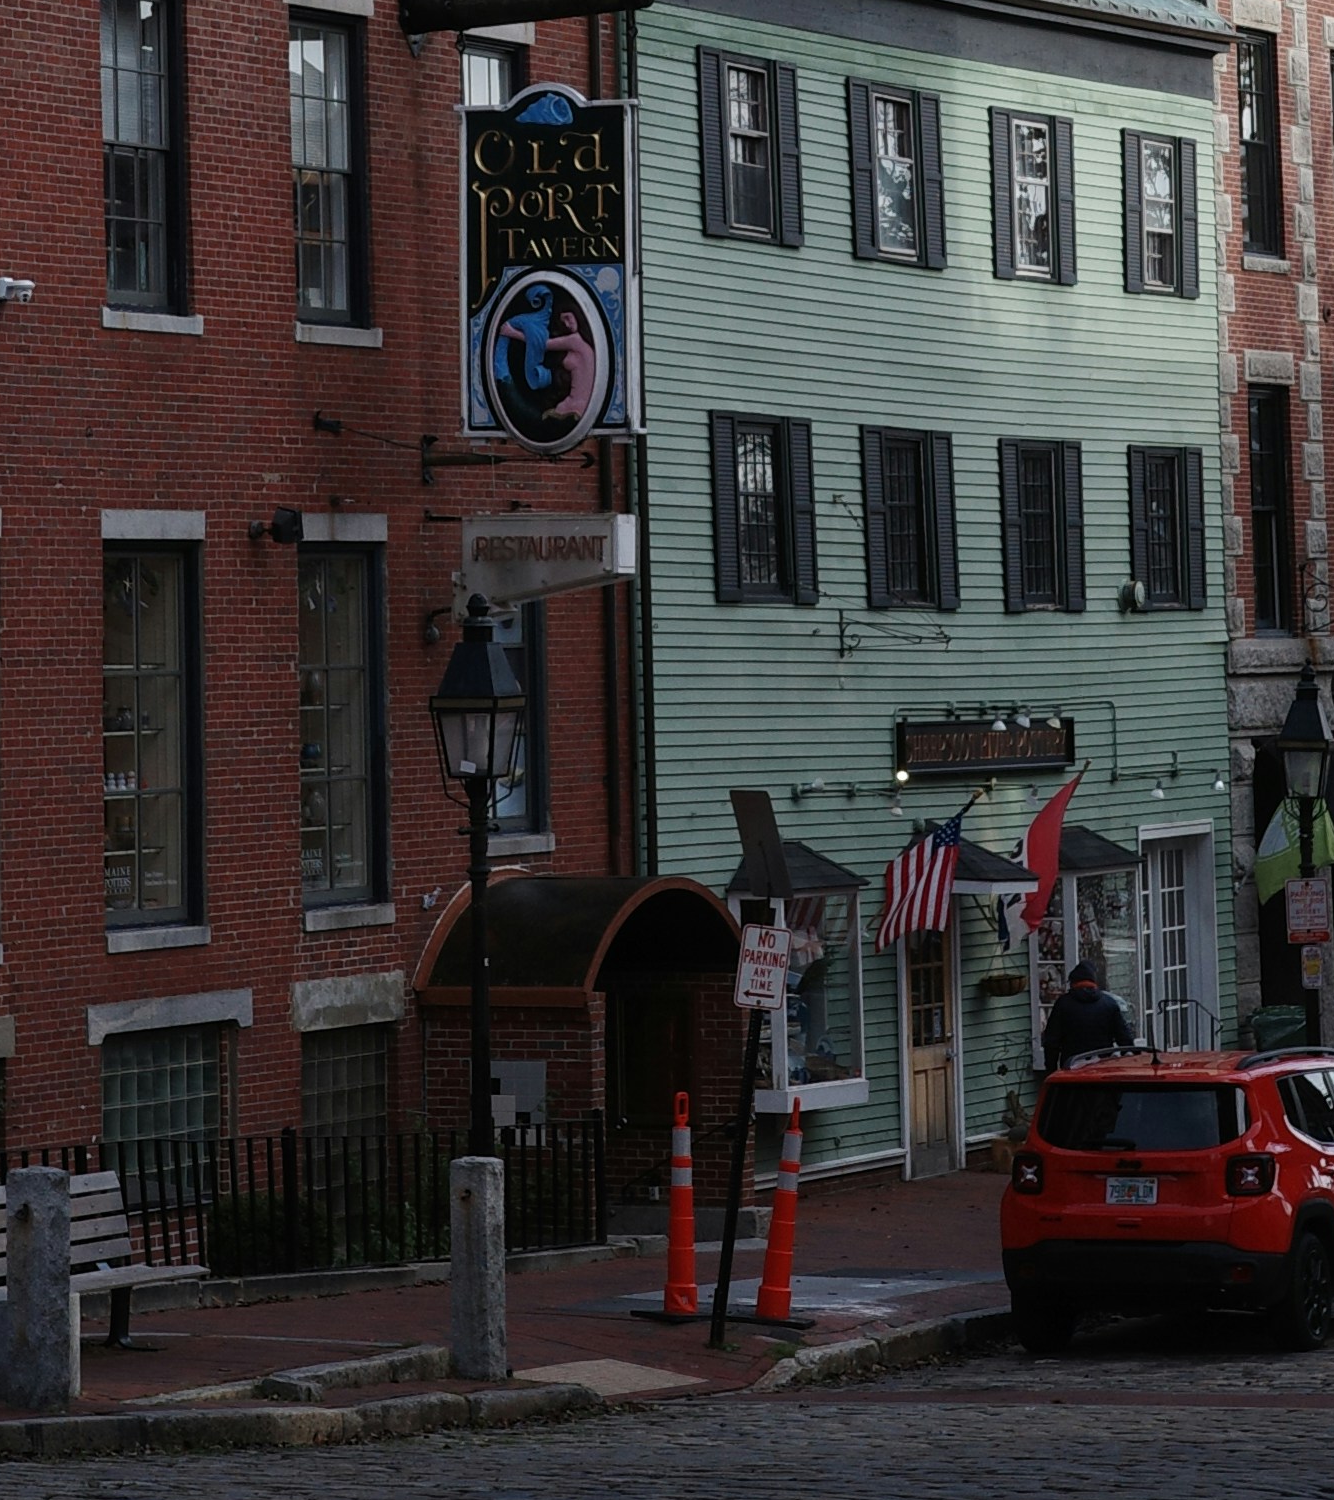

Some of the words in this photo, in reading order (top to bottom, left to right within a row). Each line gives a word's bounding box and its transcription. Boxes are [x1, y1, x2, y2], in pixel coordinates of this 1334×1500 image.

[498, 226, 621, 261] TAVERN
[471, 535, 608, 563] RESTAURANT
[104, 865, 131, 877] MAINE
[757, 931, 776, 949] NO
[743, 948, 786, 968] PARKING
[753, 967, 773, 979] ANY
[750, 978, 773, 991] TIME
